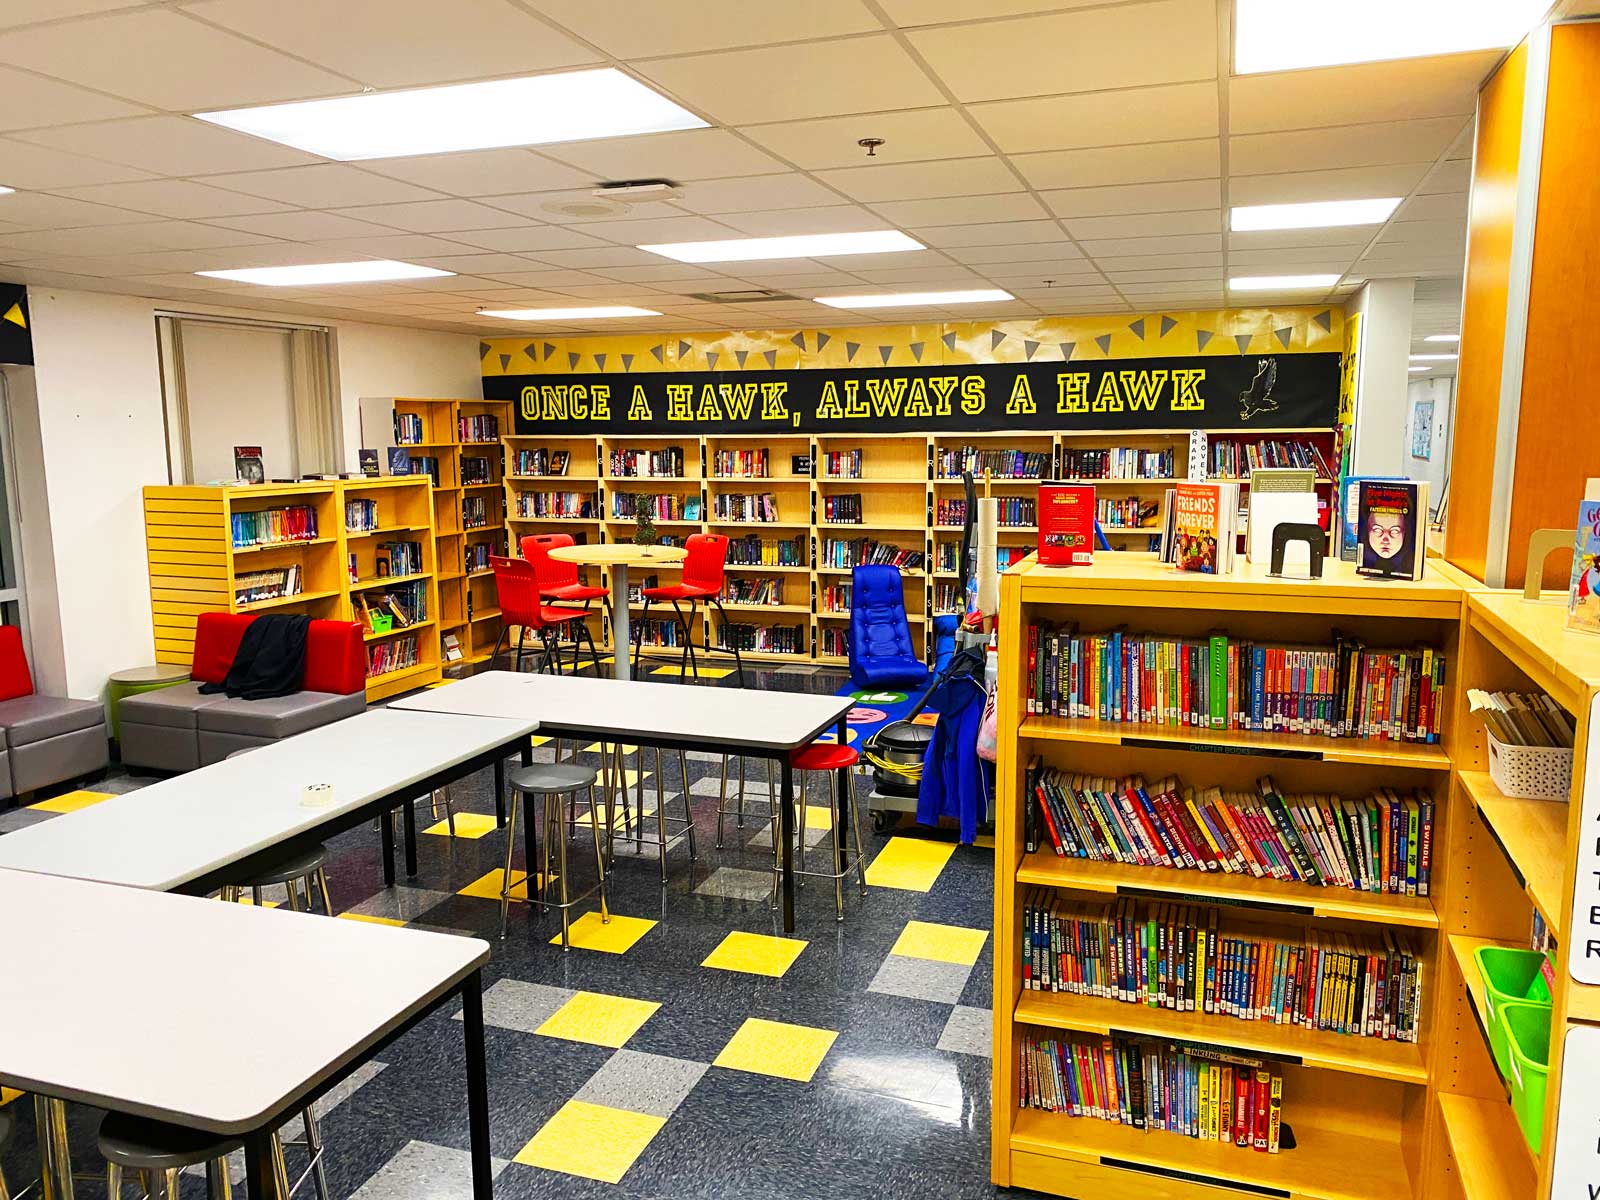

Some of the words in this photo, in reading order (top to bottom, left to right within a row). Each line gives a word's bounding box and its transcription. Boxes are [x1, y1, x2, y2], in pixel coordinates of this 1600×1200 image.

[521, 384, 610, 421] ONCE
[628, 384, 652, 421] A
[667, 382, 801, 427] HAWK,
[816, 375, 986, 419] ALWAYS
[1006, 374, 1036, 414] A
[1057, 369, 1206, 413] HAWK
[1177, 512, 1214, 529] FOREVER
[1189, 744, 1222, 753] CHAPTER
[1420, 824, 1431, 866] SWINDLE
[1183, 853, 1194, 865] HAD
